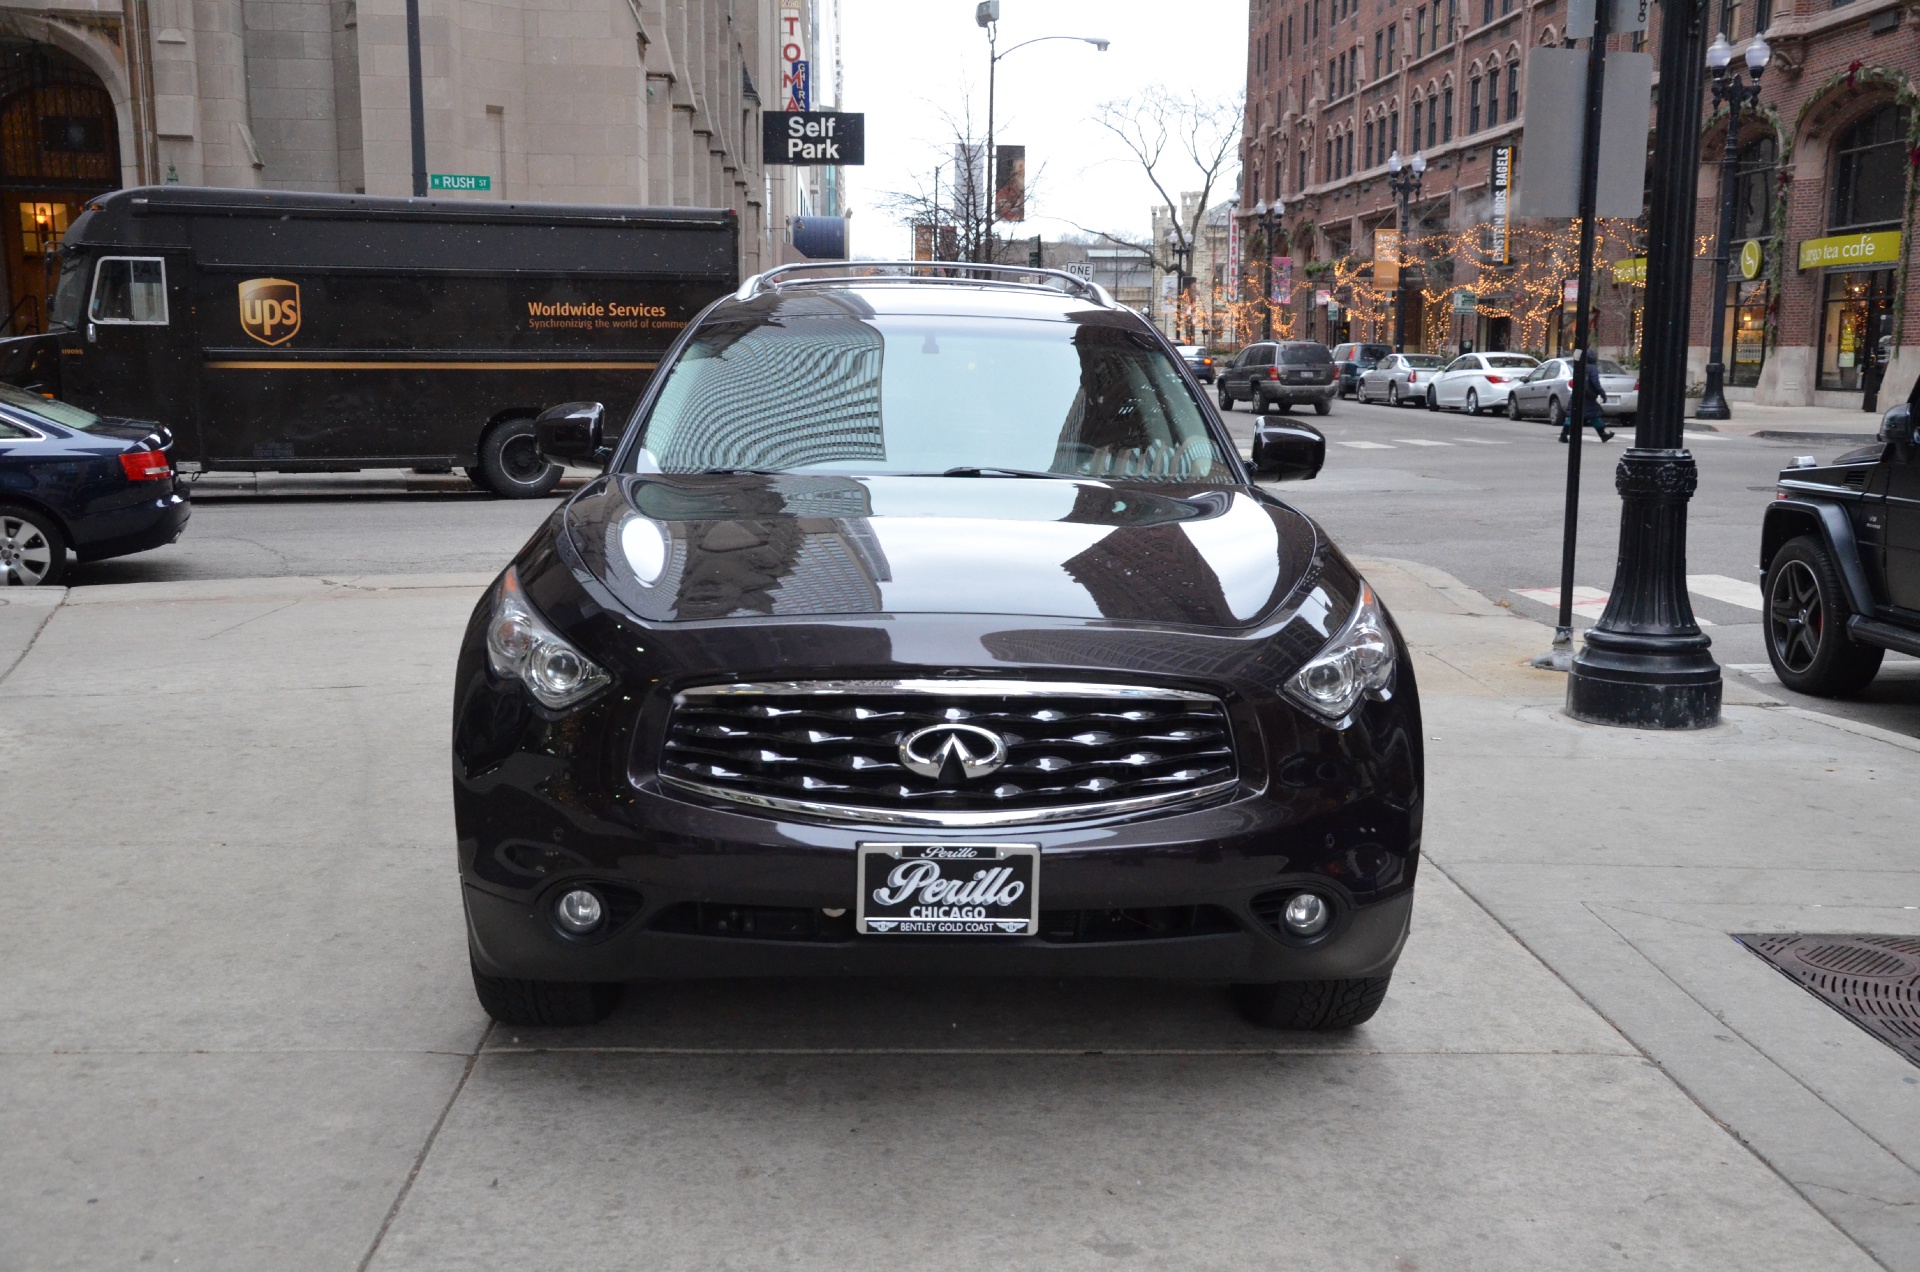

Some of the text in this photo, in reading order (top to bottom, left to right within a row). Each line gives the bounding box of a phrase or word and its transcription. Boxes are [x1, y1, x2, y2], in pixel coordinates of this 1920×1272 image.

[798, 63, 806, 112] GHIRA
[788, 116, 836, 138] Self
[787, 138, 840, 159] Park
[1495, 148, 1509, 186] BAGELS
[442, 176, 475, 189] RUSH
[478, 179, 487, 187] ST
[1492, 218, 1505, 262] EINSTEIN
[1805, 235, 1876, 265] argo tea café
[1069, 265, 1091, 276] ONE
[244, 298, 297, 336] ups
[527, 302, 667, 317] Worldwide Services
[528, 318, 593, 330] Synchronizing
[595, 318, 610, 329] the
[612, 319, 638, 329] world
[640, 319, 650, 329] of
[920, 846, 978, 858] Perillo
[873, 860, 1025, 906] Perillo
[910, 906, 986, 919] CHICAGO
[900, 922, 994, 932] BENTLEY GOLD COAST
